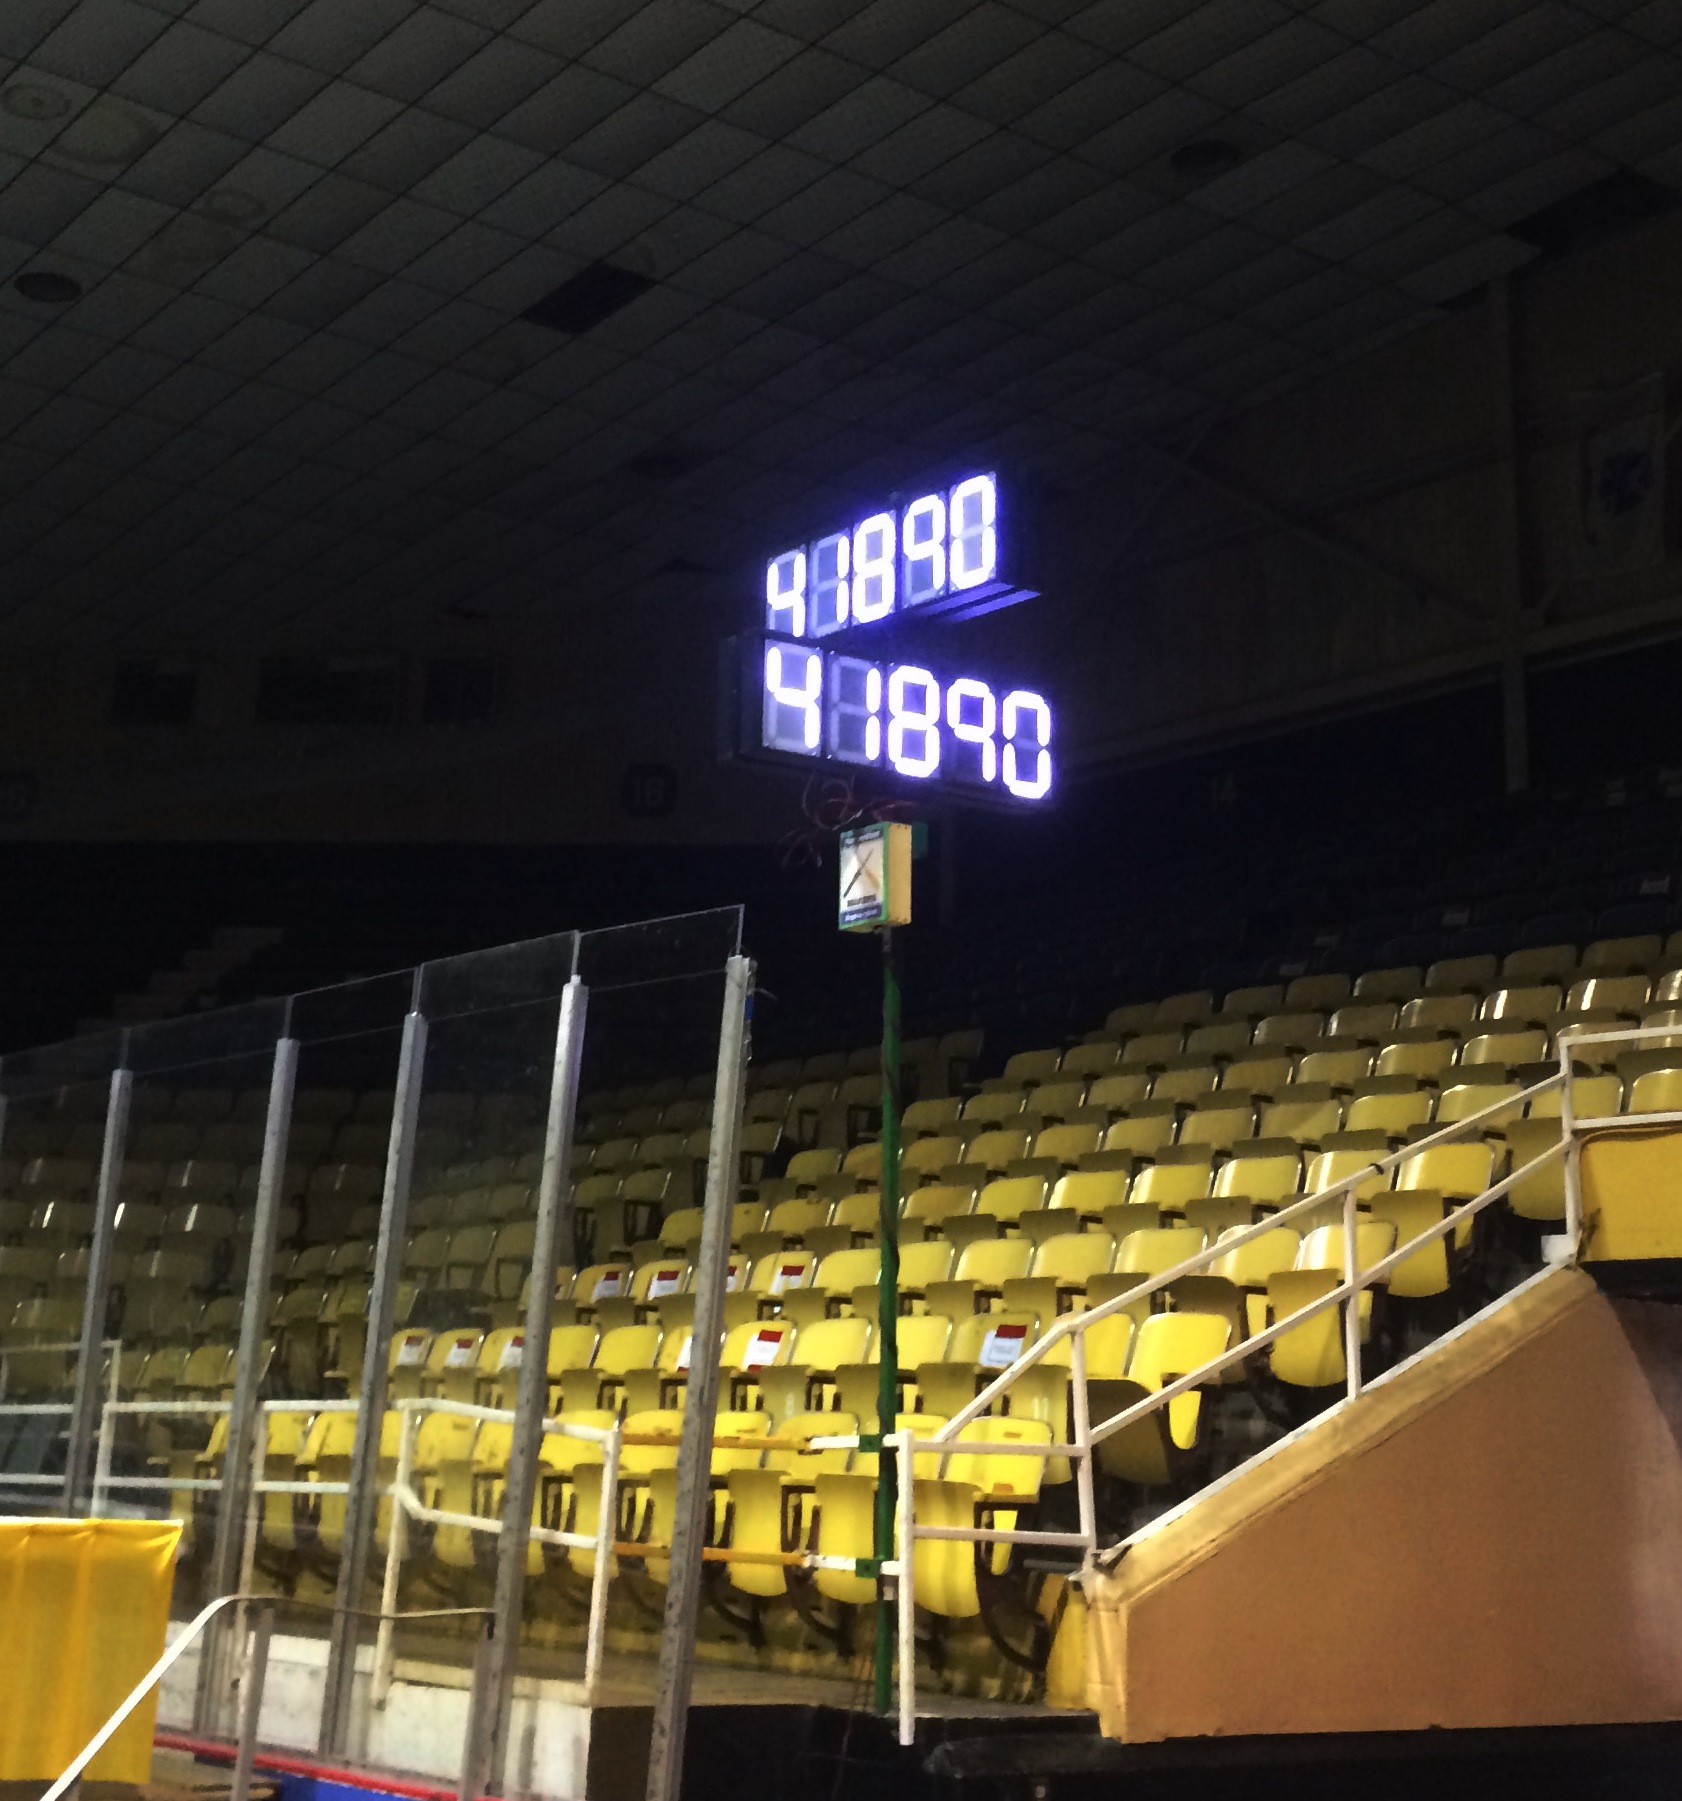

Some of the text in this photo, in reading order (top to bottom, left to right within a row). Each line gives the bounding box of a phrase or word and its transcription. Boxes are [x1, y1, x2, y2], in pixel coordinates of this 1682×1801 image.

[766, 475, 996, 637] 41890
[633, 777, 665, 807] 16
[766, 646, 1051, 799] 41890
